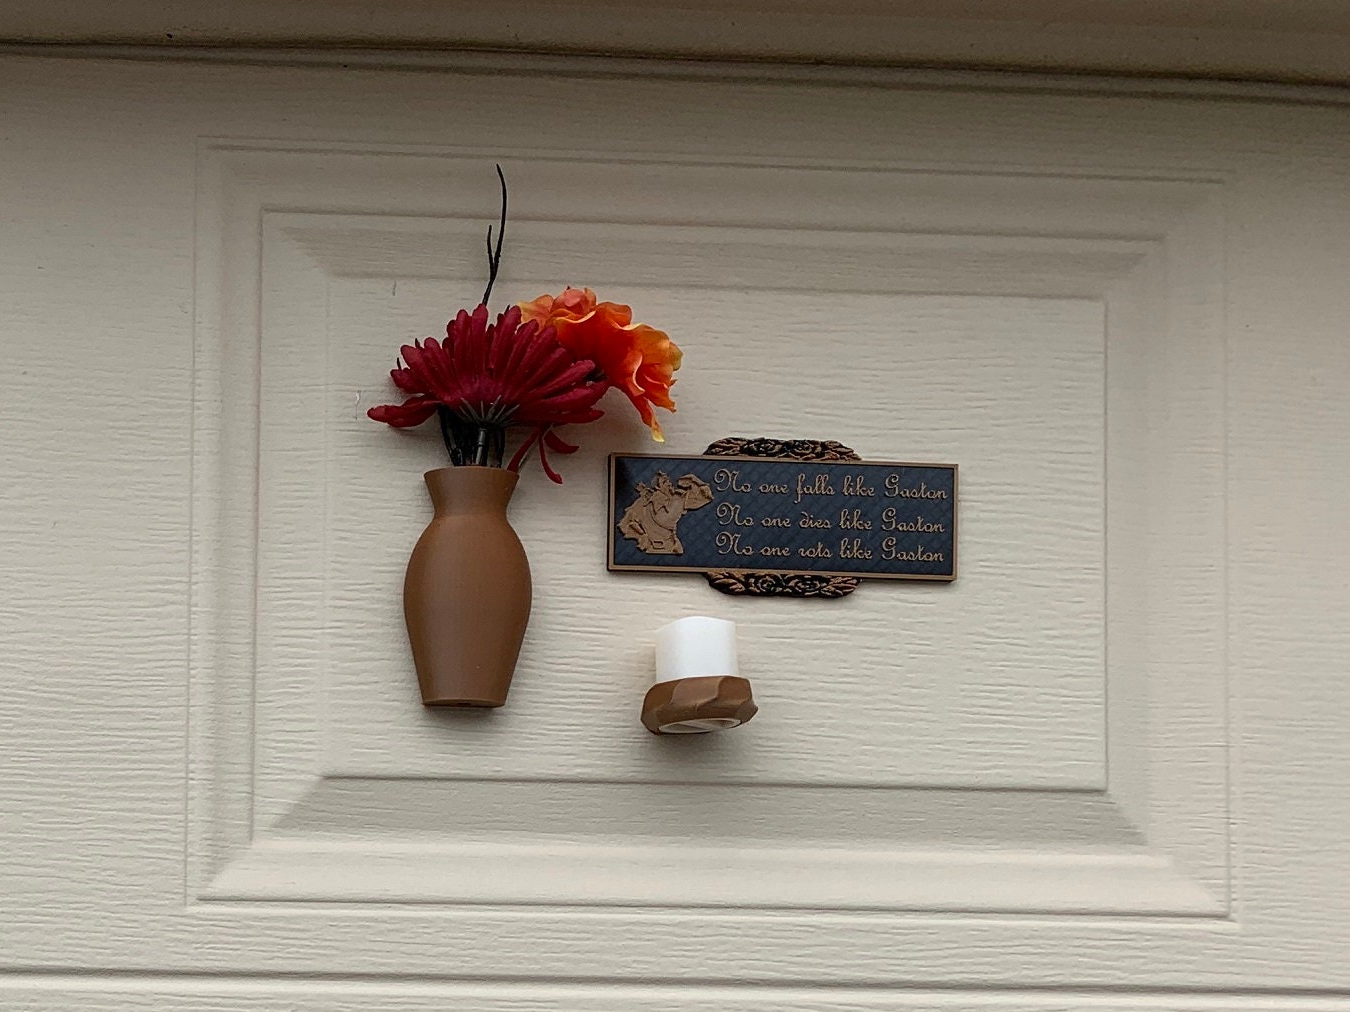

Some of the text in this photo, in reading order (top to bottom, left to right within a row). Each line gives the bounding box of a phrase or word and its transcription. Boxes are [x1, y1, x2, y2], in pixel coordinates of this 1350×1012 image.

[713, 468, 947, 503] No one falls like Gaston
[716, 502, 945, 533] No one dies like Gaston
[716, 532, 945, 563] No one rots like Gaston
